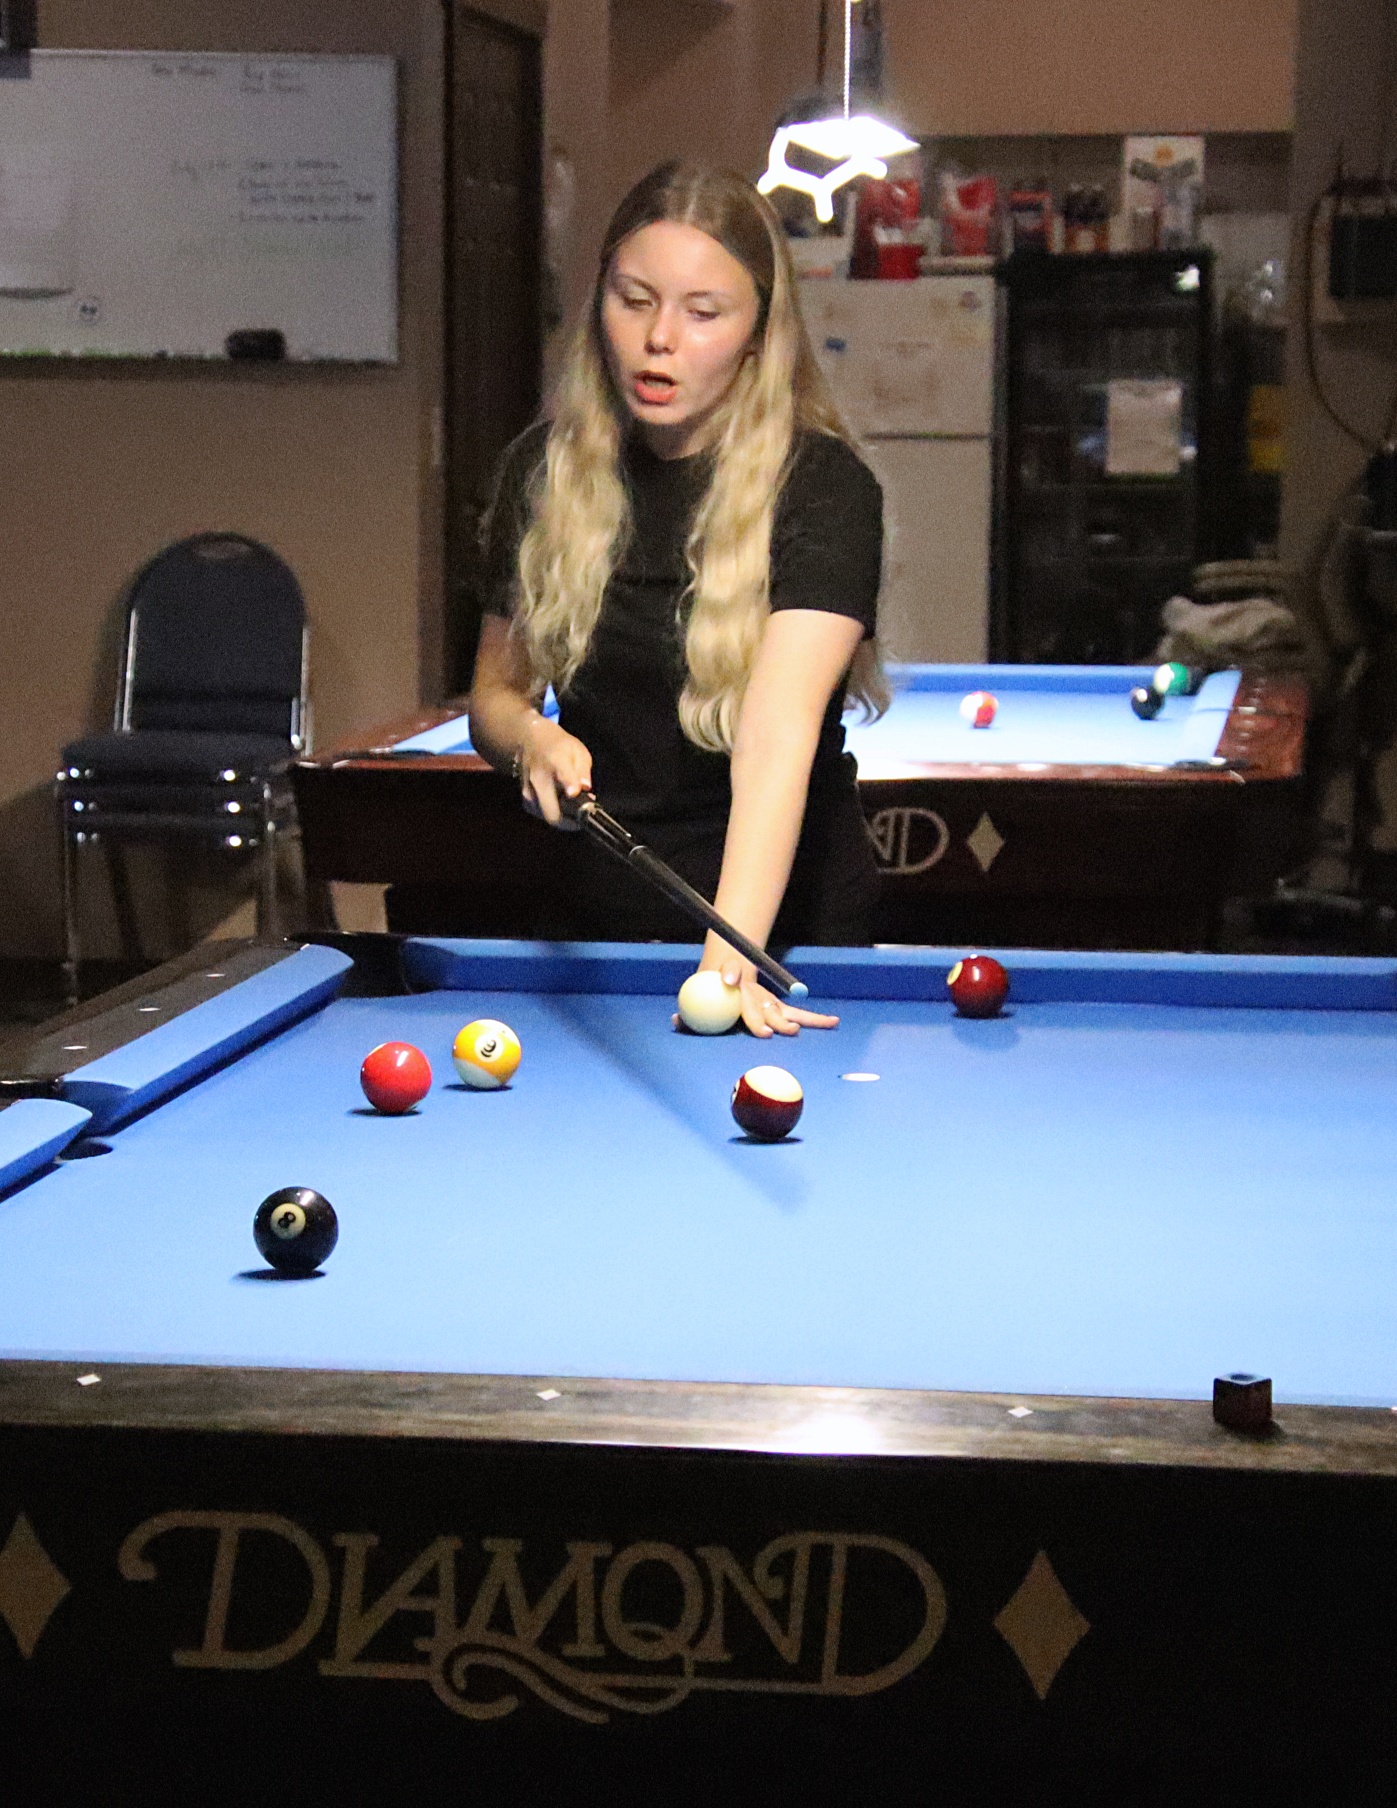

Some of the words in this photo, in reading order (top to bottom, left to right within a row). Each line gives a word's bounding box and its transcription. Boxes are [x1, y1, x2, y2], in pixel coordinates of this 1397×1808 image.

[481, 1039, 497, 1058] 9
[278, 1211, 296, 1230] 8
[118, 1510, 948, 1724] DIAMOND
